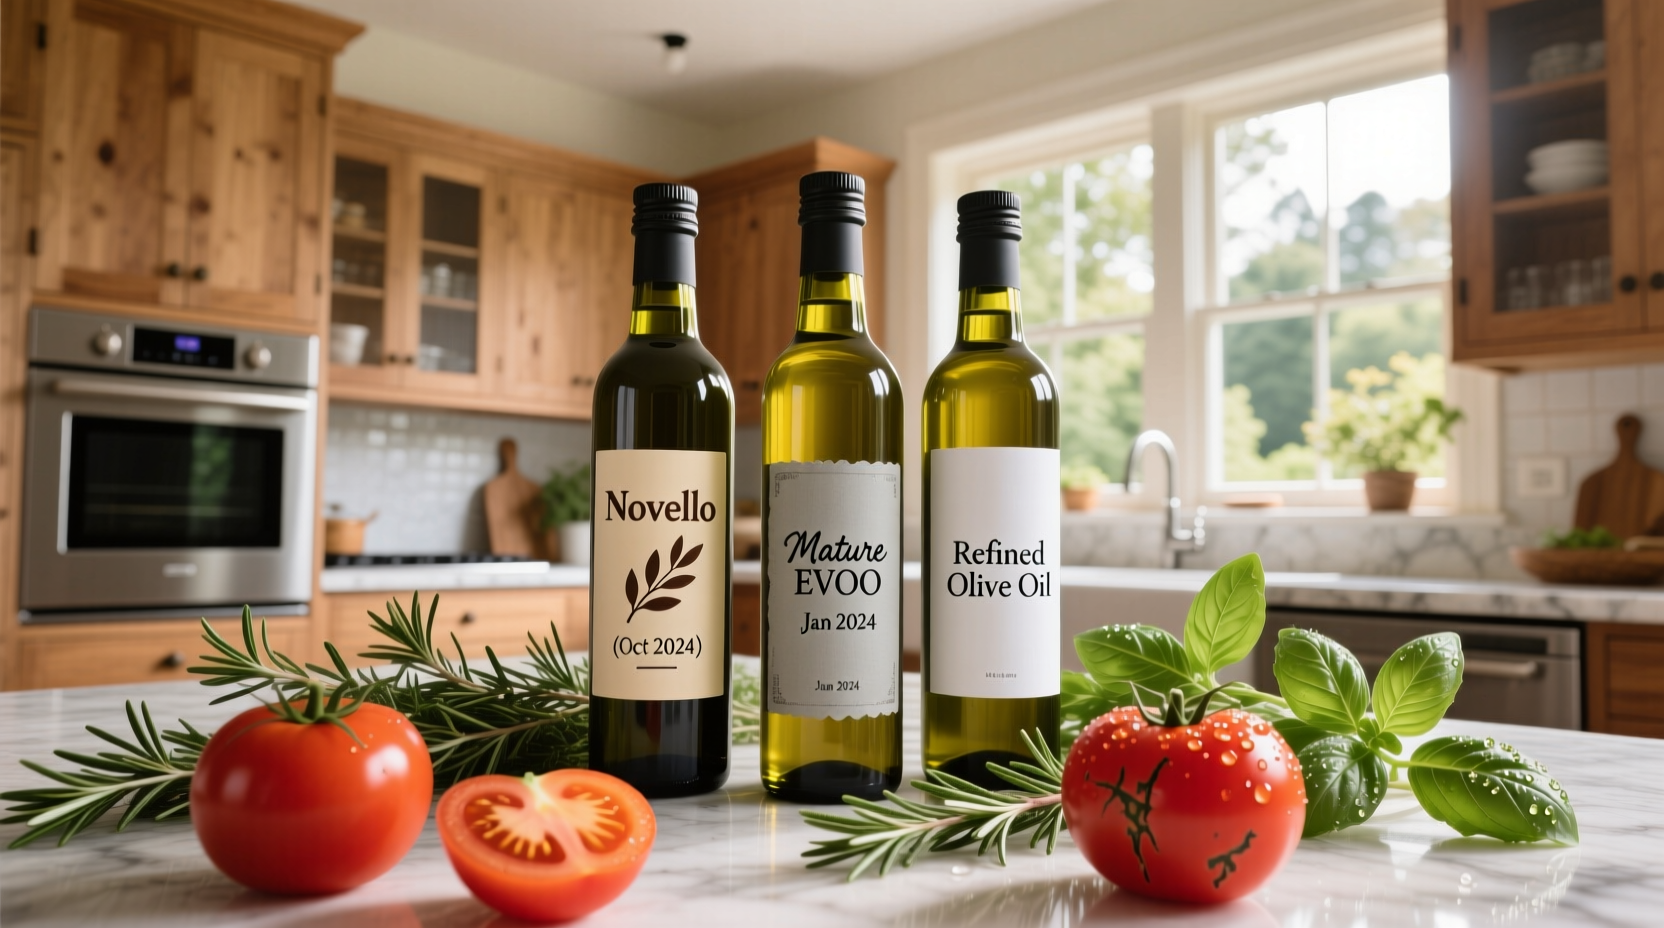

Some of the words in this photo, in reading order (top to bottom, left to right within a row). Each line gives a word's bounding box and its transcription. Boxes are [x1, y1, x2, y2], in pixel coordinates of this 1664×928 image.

[605, 489, 717, 522] Novello
[783, 530, 888, 565] Mature
[952, 538, 1045, 566] Refined
[793, 568, 882, 596] EVOO
[947, 571, 1012, 598] Olive
[1018, 571, 1052, 598] Oil
[800, 611, 832, 635] Jan
[836, 612, 877, 631] 2024
[613, 634, 649, 659] (Oct
[653, 634, 703, 660] 2024)
[836, 680, 860, 691] 2024
